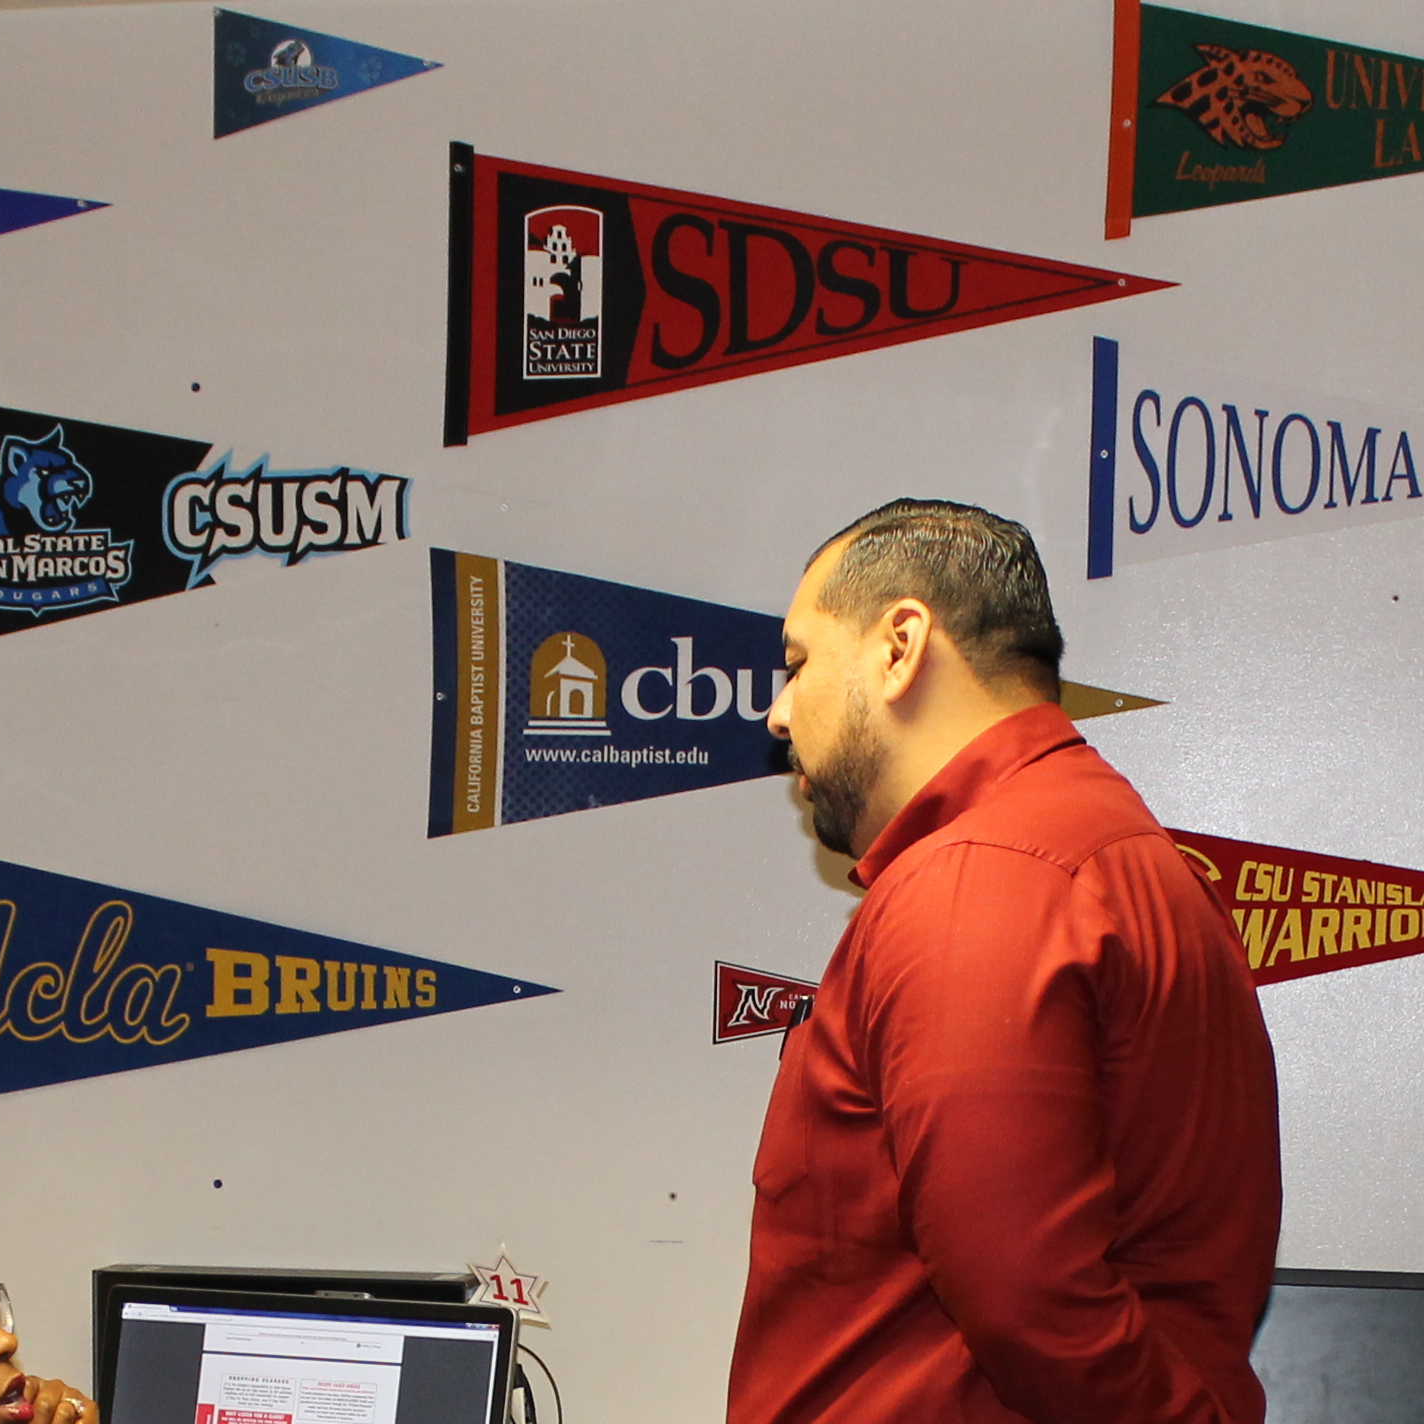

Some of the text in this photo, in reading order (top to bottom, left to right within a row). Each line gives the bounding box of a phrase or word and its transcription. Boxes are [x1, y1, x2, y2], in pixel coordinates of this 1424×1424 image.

[244, 66, 339, 93] CSUSB
[1373, 118, 1423, 169] LA
[1175, 150, 1266, 191] Leopards
[649, 212, 969, 373] SDSU
[529, 327, 596, 340] SAN DIEGO
[529, 340, 596, 361] STATE
[529, 362, 595, 373] UNIVERSITY
[1128, 388, 1424, 535] SONOMA
[173, 475, 402, 557] CSUSM
[24, 533, 106, 553] STATE
[11, 549, 126, 582] MARCOS
[466, 575, 485, 813] CALIFORNIA BAPTIST UNIVERSITY
[620, 636, 788, 721] cbu
[525, 745, 710, 768] www.calbaptist.edu
[1235, 859, 1294, 903] CSU
[204, 946, 437, 1019] BRUINS
[490, 1274, 530, 1306] 11
